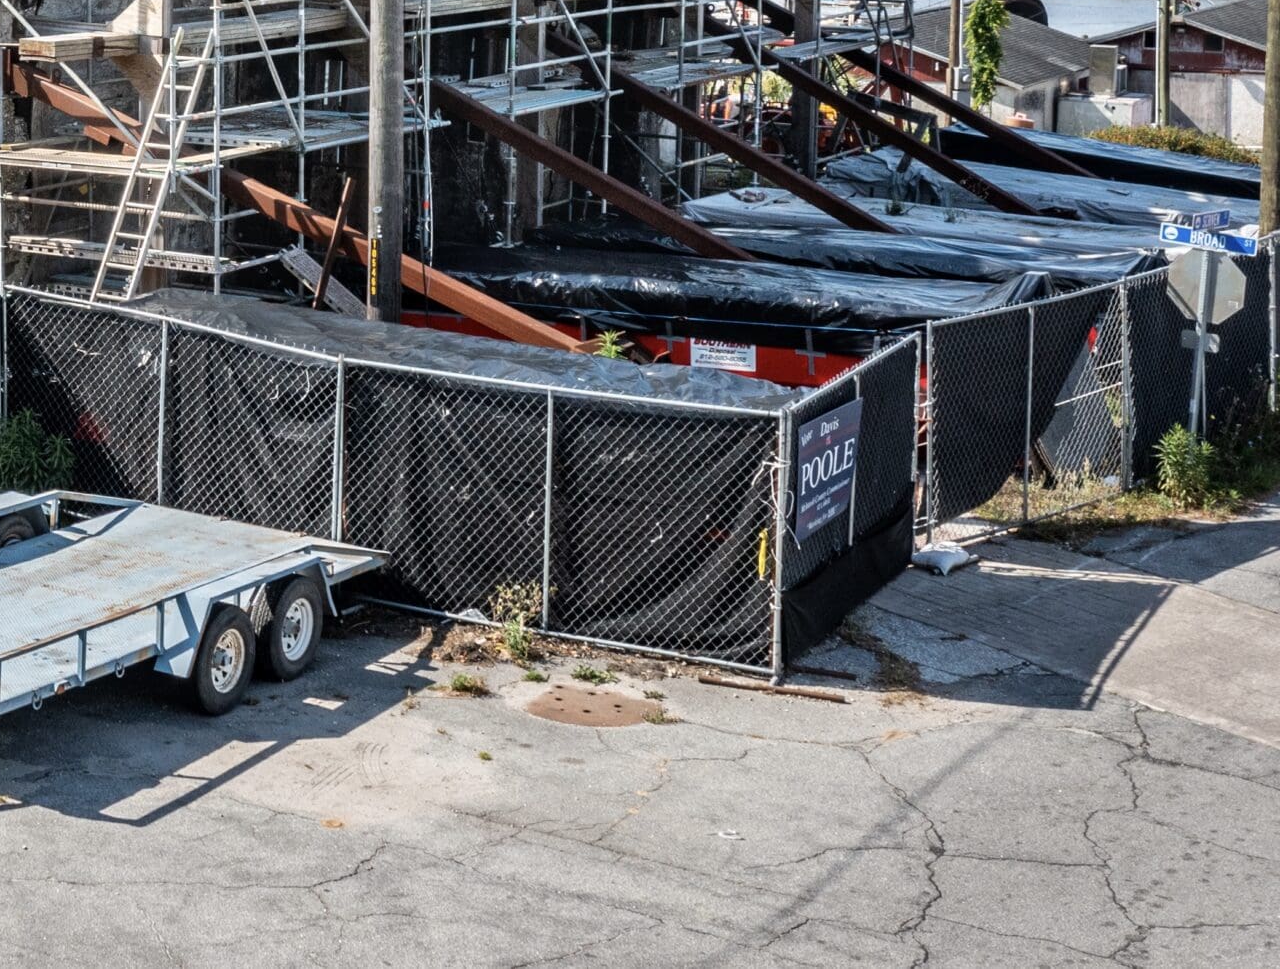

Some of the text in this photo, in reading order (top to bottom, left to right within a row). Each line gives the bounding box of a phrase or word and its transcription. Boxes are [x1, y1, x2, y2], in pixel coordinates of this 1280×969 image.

[1190, 231, 1253, 248] BROAD ST
[709, 347, 736, 355] Disposal
[820, 416, 840, 437] Davis
[801, 438, 855, 496] POOLE
